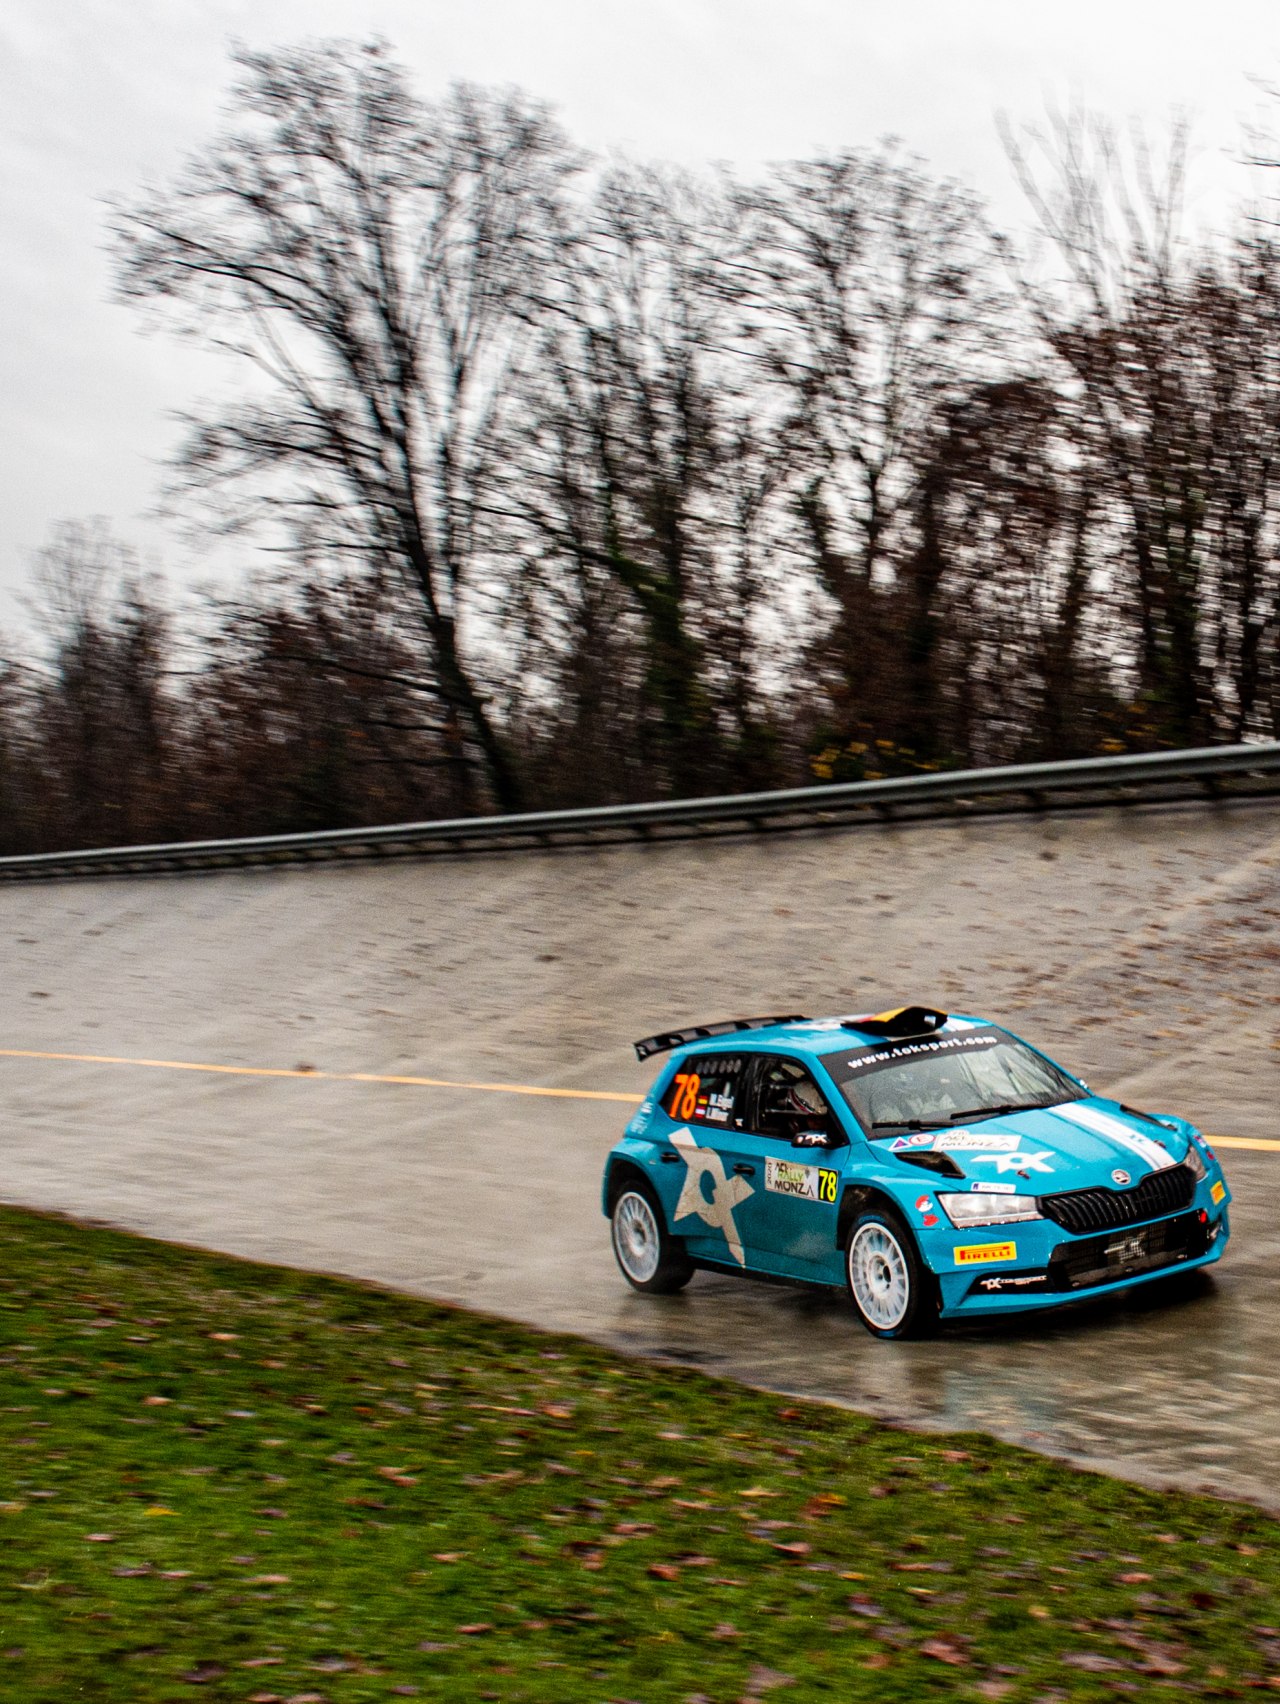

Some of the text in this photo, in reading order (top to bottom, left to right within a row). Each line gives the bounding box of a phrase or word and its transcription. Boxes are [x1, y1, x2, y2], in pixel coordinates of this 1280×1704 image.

[848, 1036, 998, 1069] www.toksport.com
[668, 1073, 701, 1120] 78
[778, 1168, 804, 1182] RALLY
[819, 1170, 837, 1202] 78
[774, 1180, 815, 1197] MONZA
[960, 1246, 1010, 1260] PIRELLI
